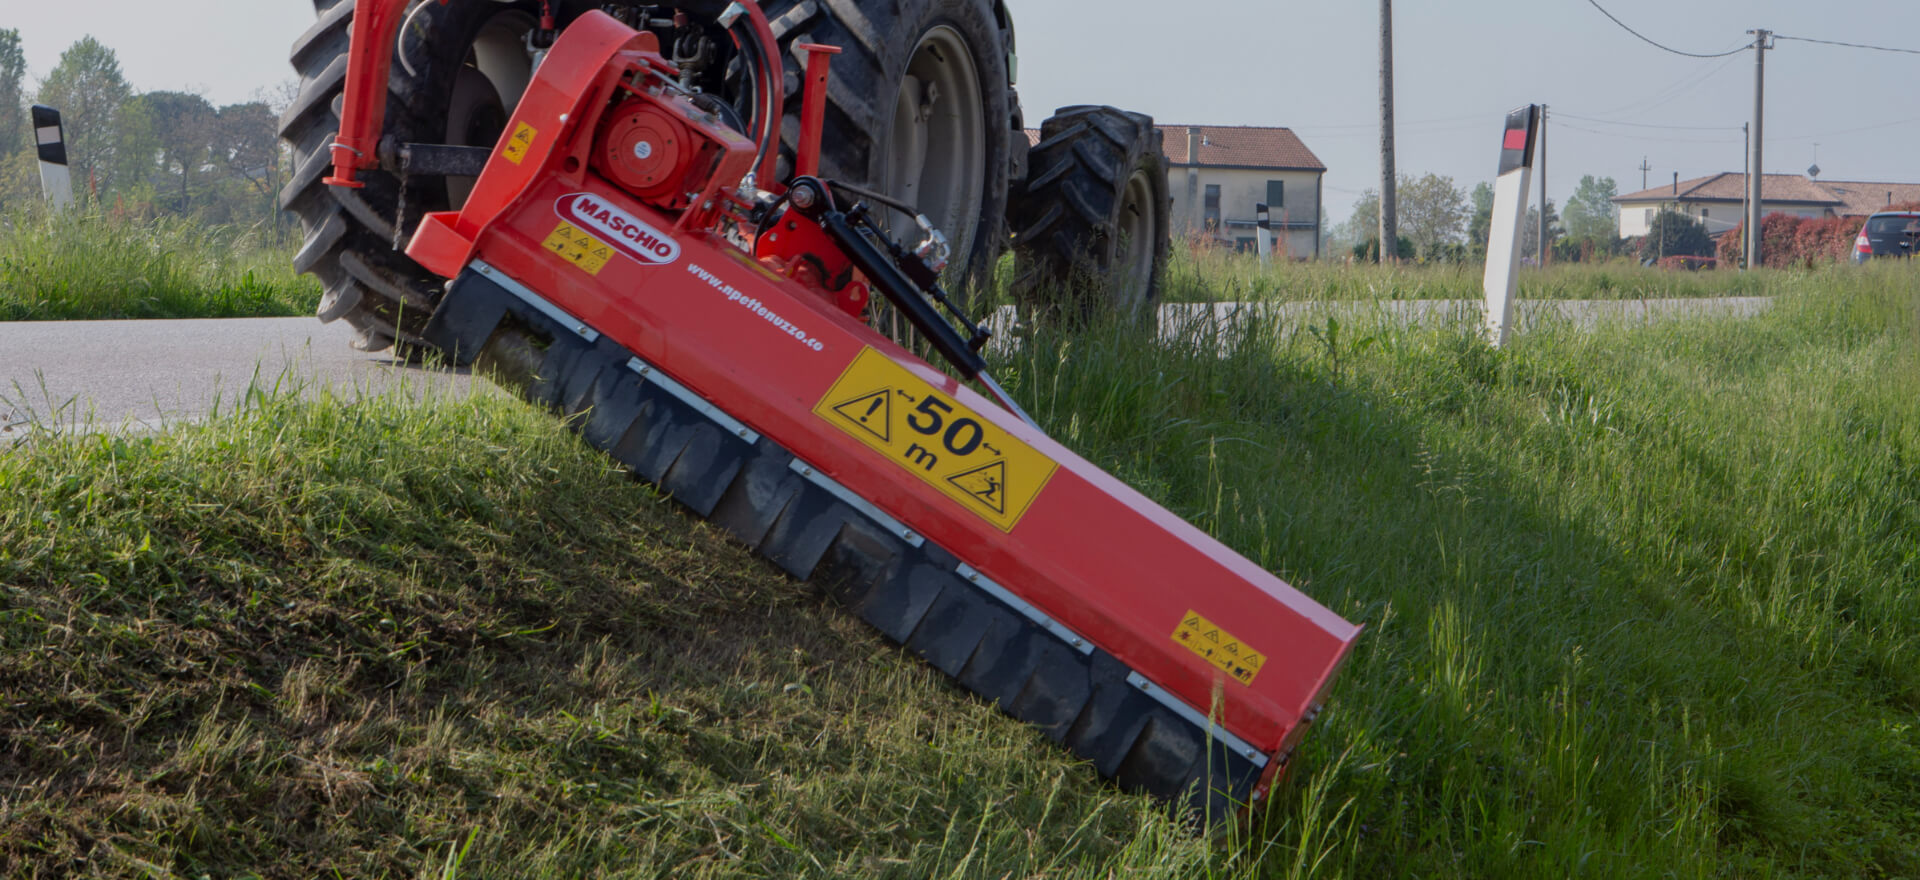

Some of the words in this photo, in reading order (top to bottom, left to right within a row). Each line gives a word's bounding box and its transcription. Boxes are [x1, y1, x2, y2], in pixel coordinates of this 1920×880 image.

[577, 198, 671, 257] MASCHIO
[907, 395, 984, 456] 50
[904, 443, 938, 471] m
